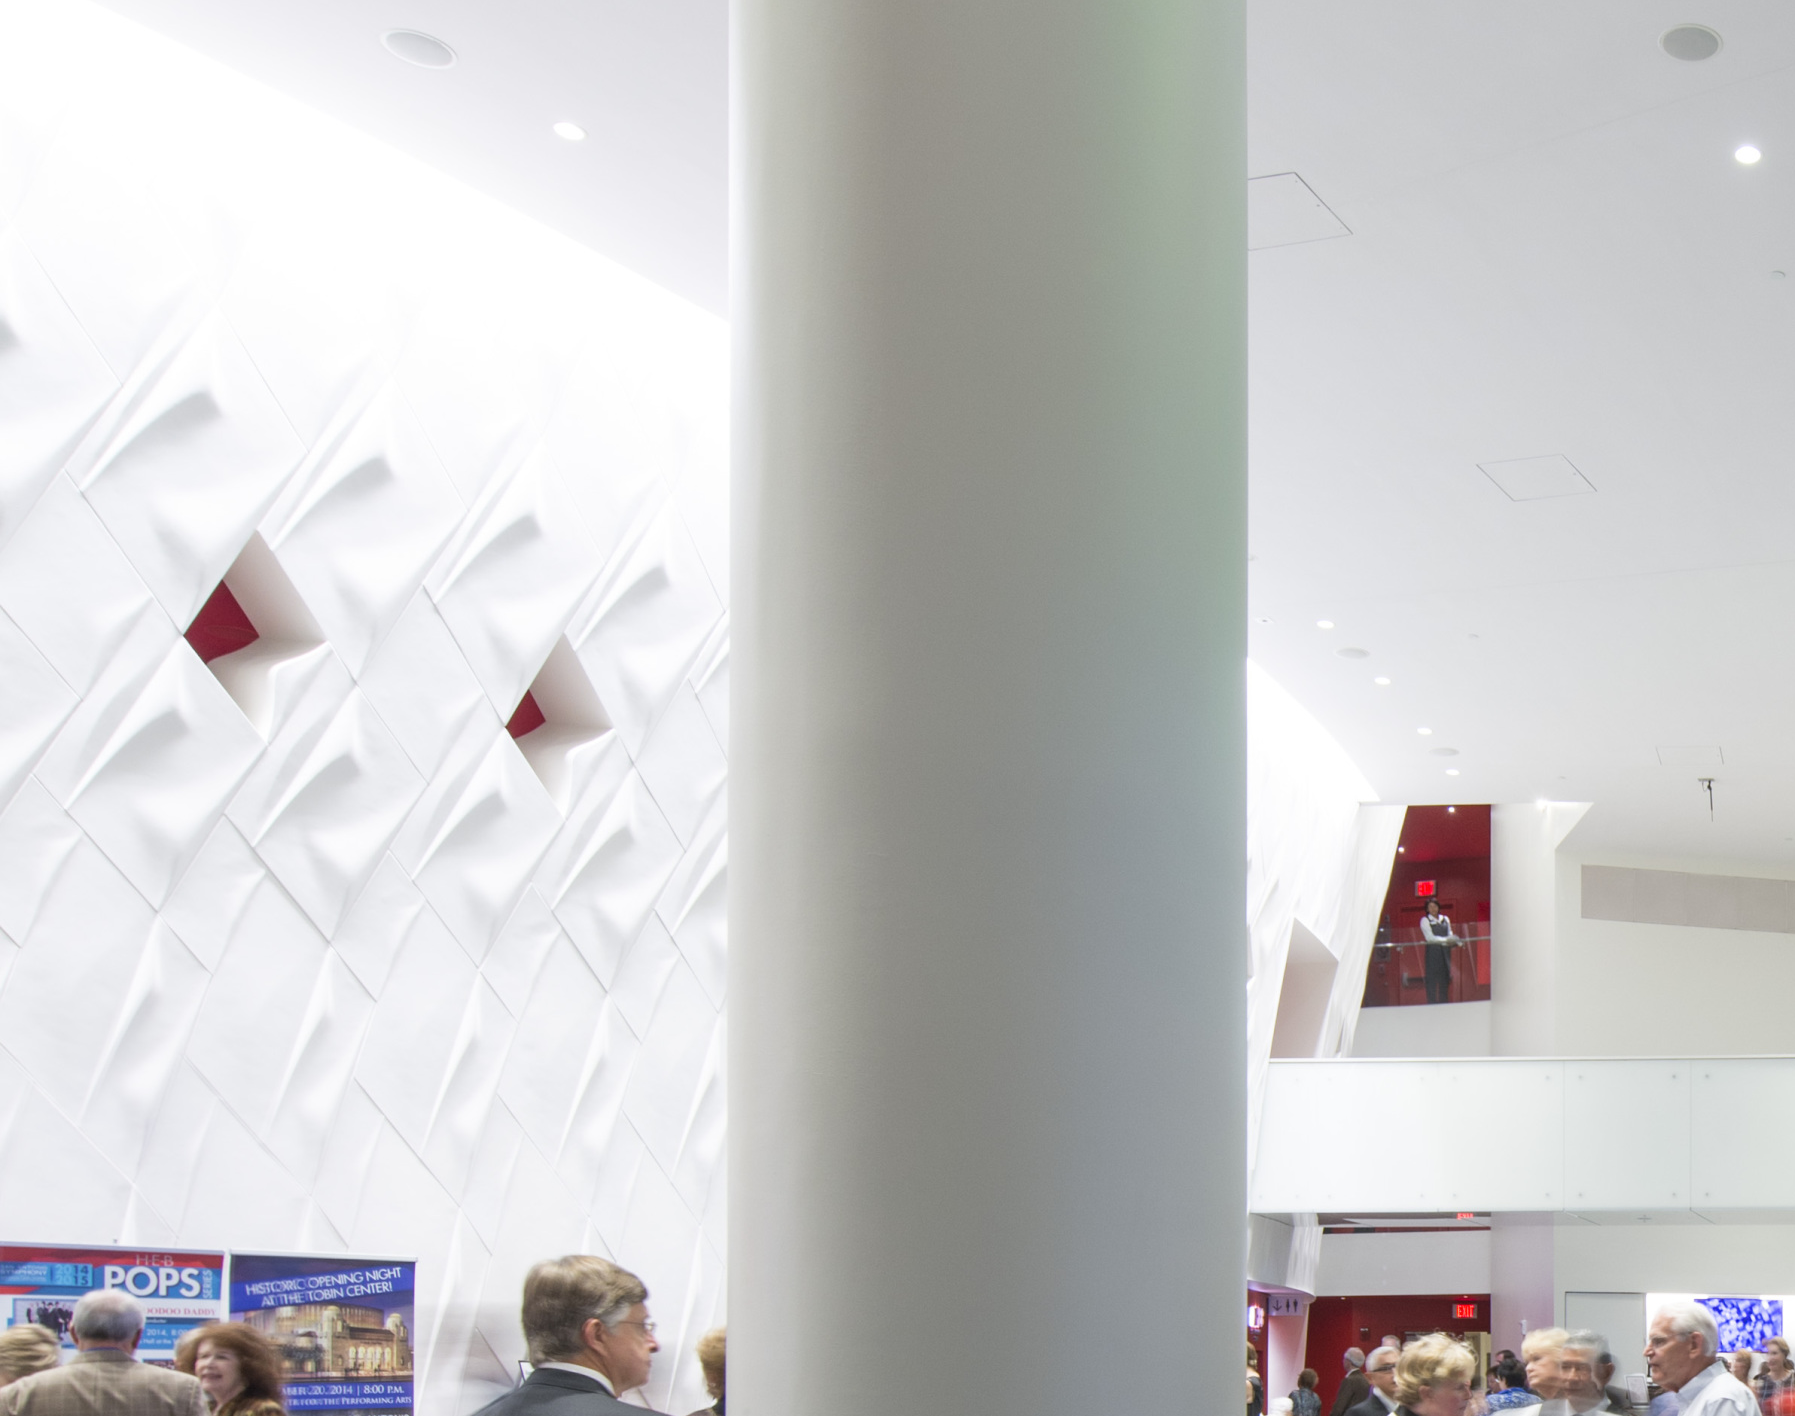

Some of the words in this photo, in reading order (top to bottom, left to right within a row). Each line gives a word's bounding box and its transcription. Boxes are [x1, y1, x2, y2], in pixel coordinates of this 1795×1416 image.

[55, 1264, 89, 1275] 2014
[55, 1275, 89, 1285] 2015
[103, 1265, 202, 1298] POPS
[203, 1269, 213, 1299] SERIES
[307, 1271, 364, 1288] OPENING
[365, 1267, 402, 1282] NIGHT
[306, 1288, 344, 1302] TOBIN
[345, 1281, 393, 1297] CENTER!
[183, 1308, 216, 1316] DADDY
[1456, 1304, 1475, 1318] EXIT
[331, 1384, 353, 1395] 2014
[363, 1384, 384, 1394] 8:00
[386, 1385, 405, 1394] P.M.
